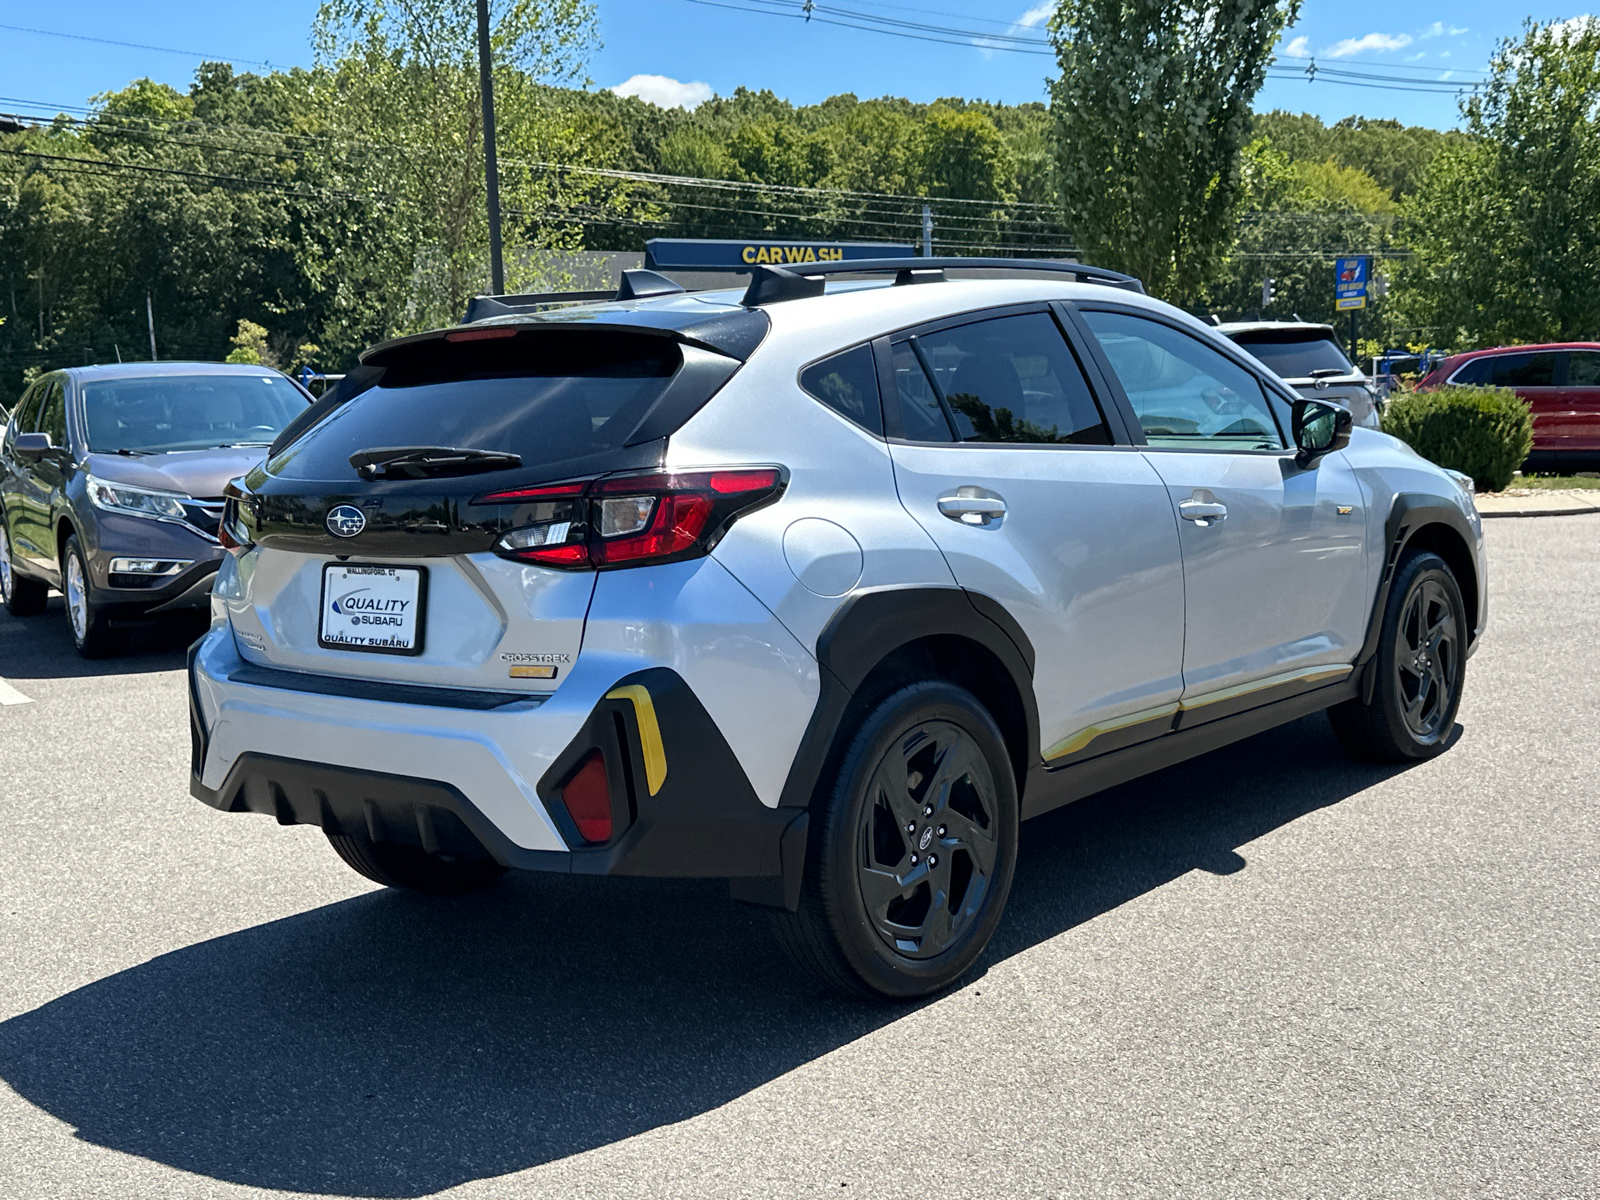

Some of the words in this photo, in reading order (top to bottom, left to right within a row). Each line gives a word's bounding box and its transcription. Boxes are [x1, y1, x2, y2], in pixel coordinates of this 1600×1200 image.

[345, 597, 410, 612] QUALITY
[361, 615, 403, 626] SUBARU
[324, 634, 366, 645] QUALITY
[368, 638, 410, 648] SUBARU
[500, 653, 570, 663] CROSSTREK
